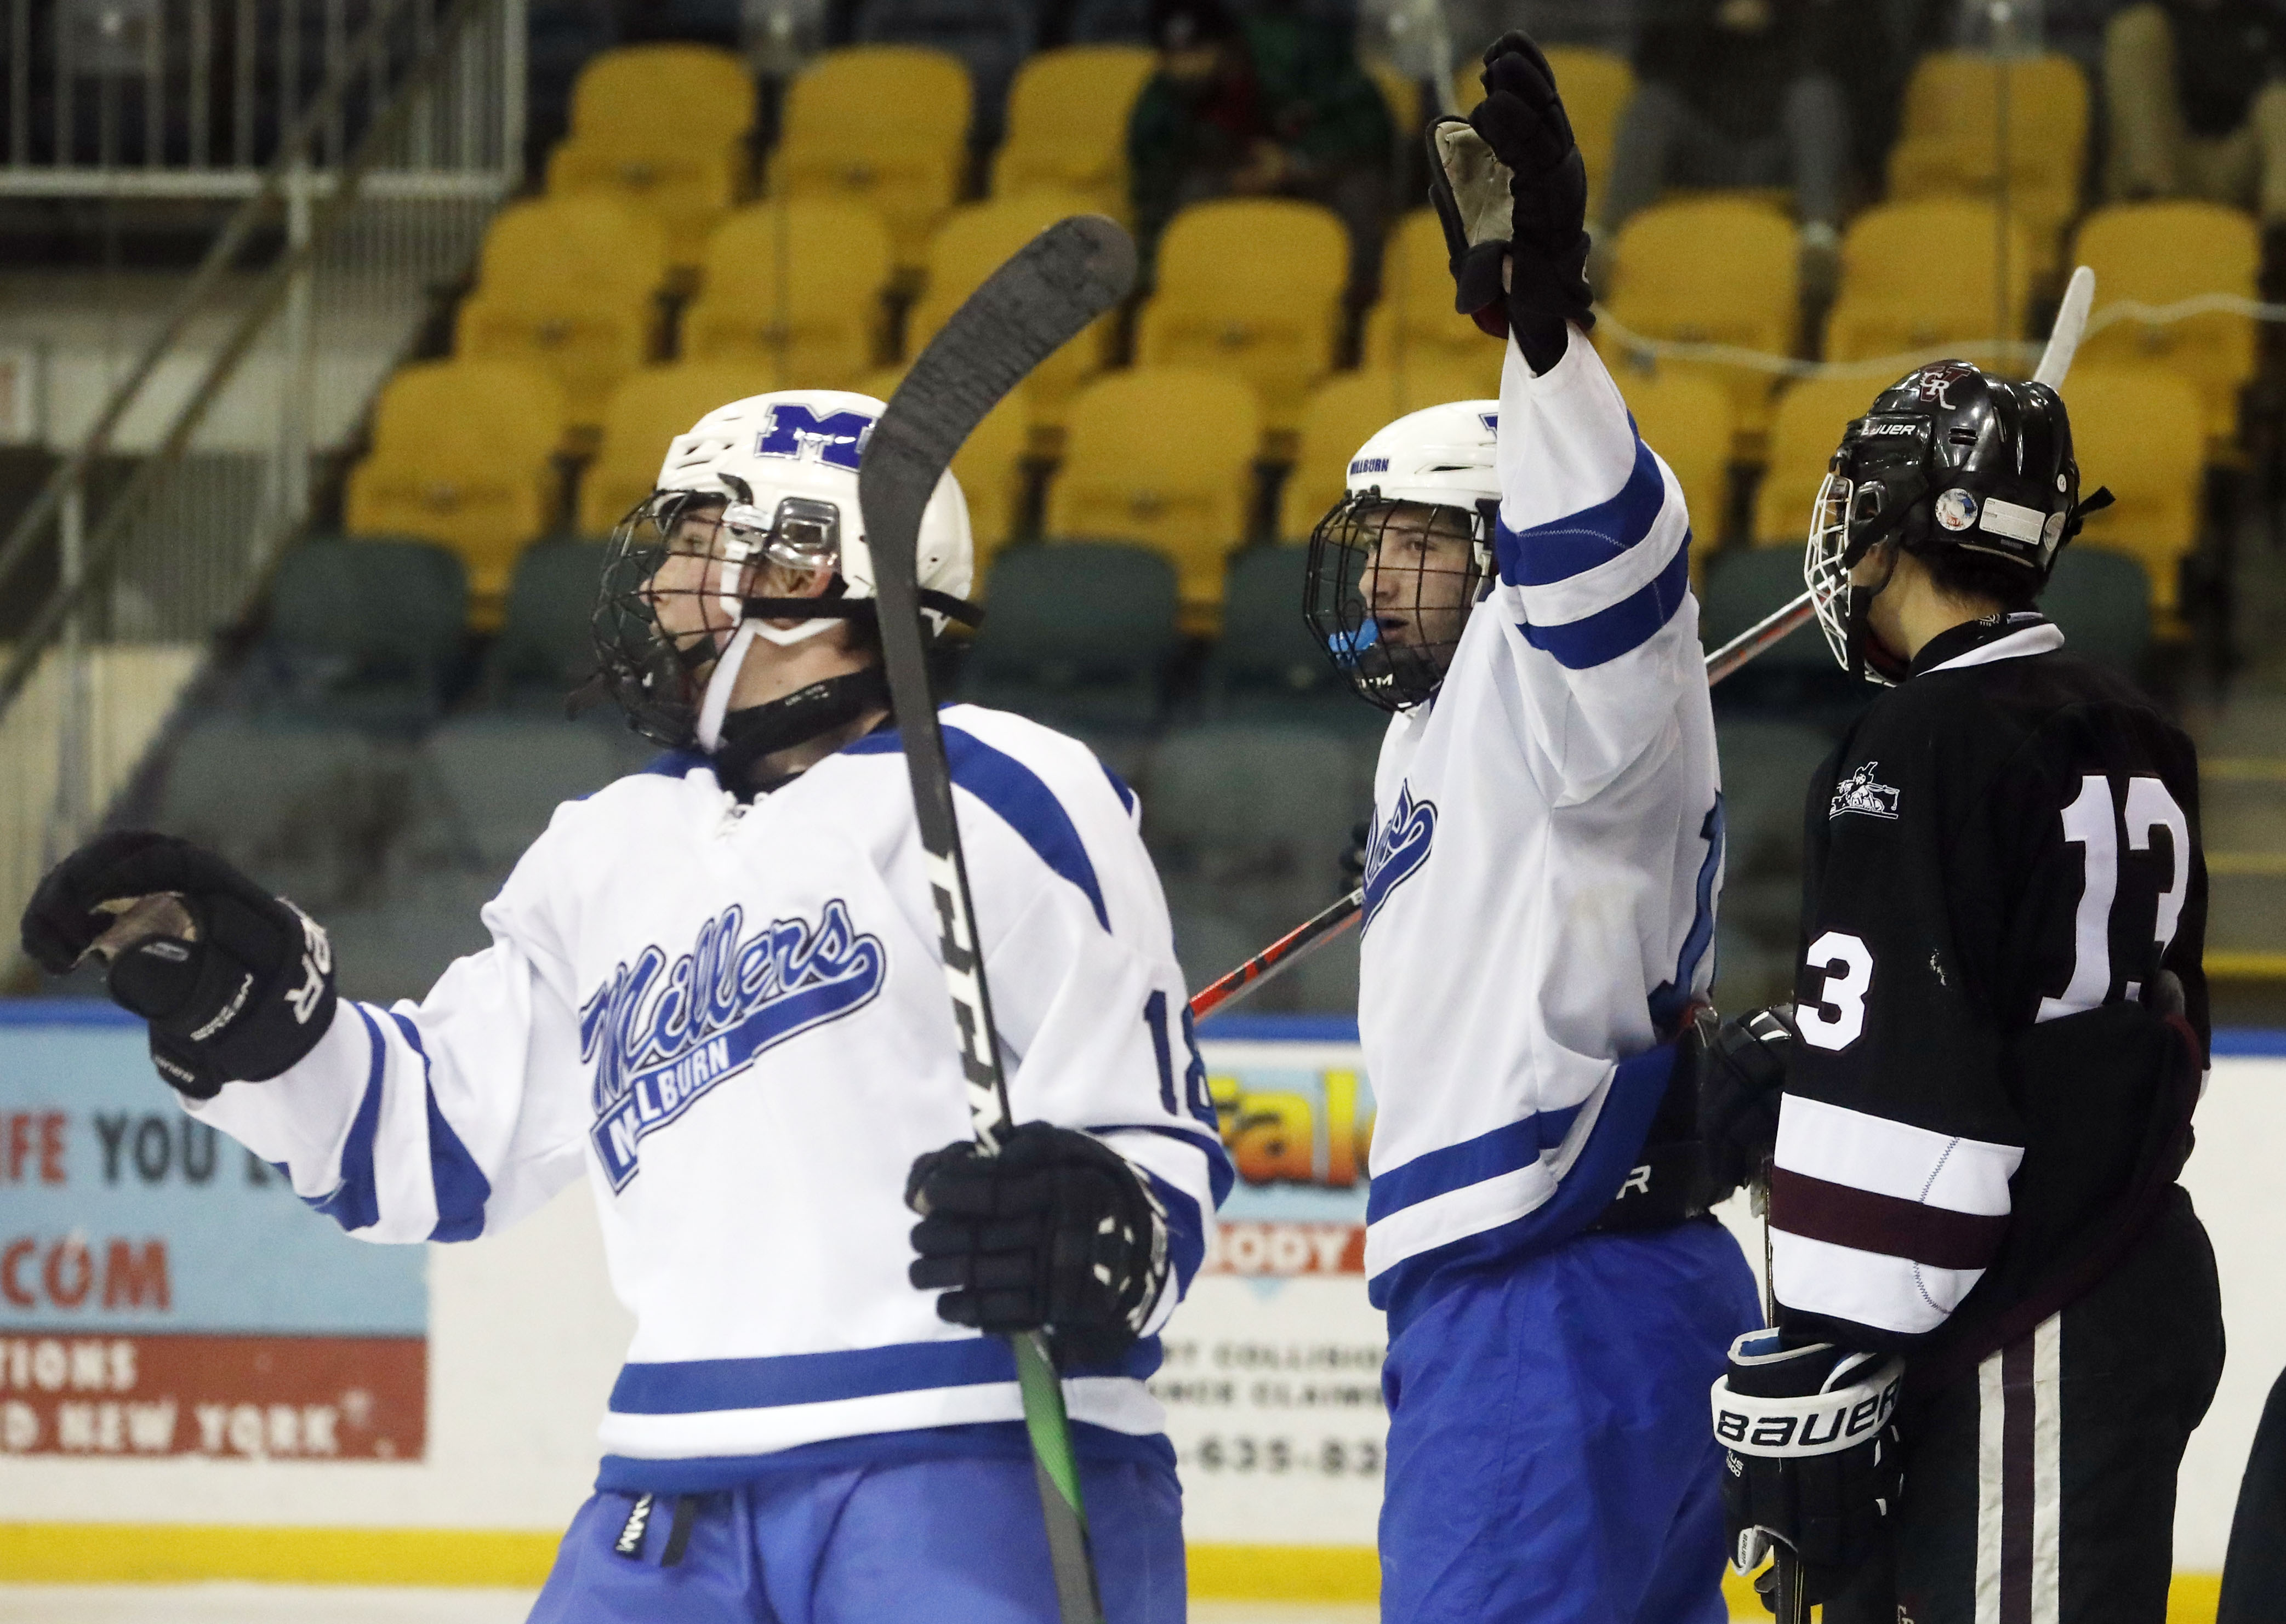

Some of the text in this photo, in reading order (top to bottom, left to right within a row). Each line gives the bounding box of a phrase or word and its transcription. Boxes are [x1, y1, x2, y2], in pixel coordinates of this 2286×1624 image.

[579, 897, 887, 1118] Millers
[5, 1112, 68, 1185] FE
[94, 1114, 217, 1187] YOU
[2, 1236, 172, 1310] COM
[58, 1400, 178, 1451] NEW
[196, 1402, 341, 1453] YORK
[1717, 1375, 1902, 1446] BAUER
